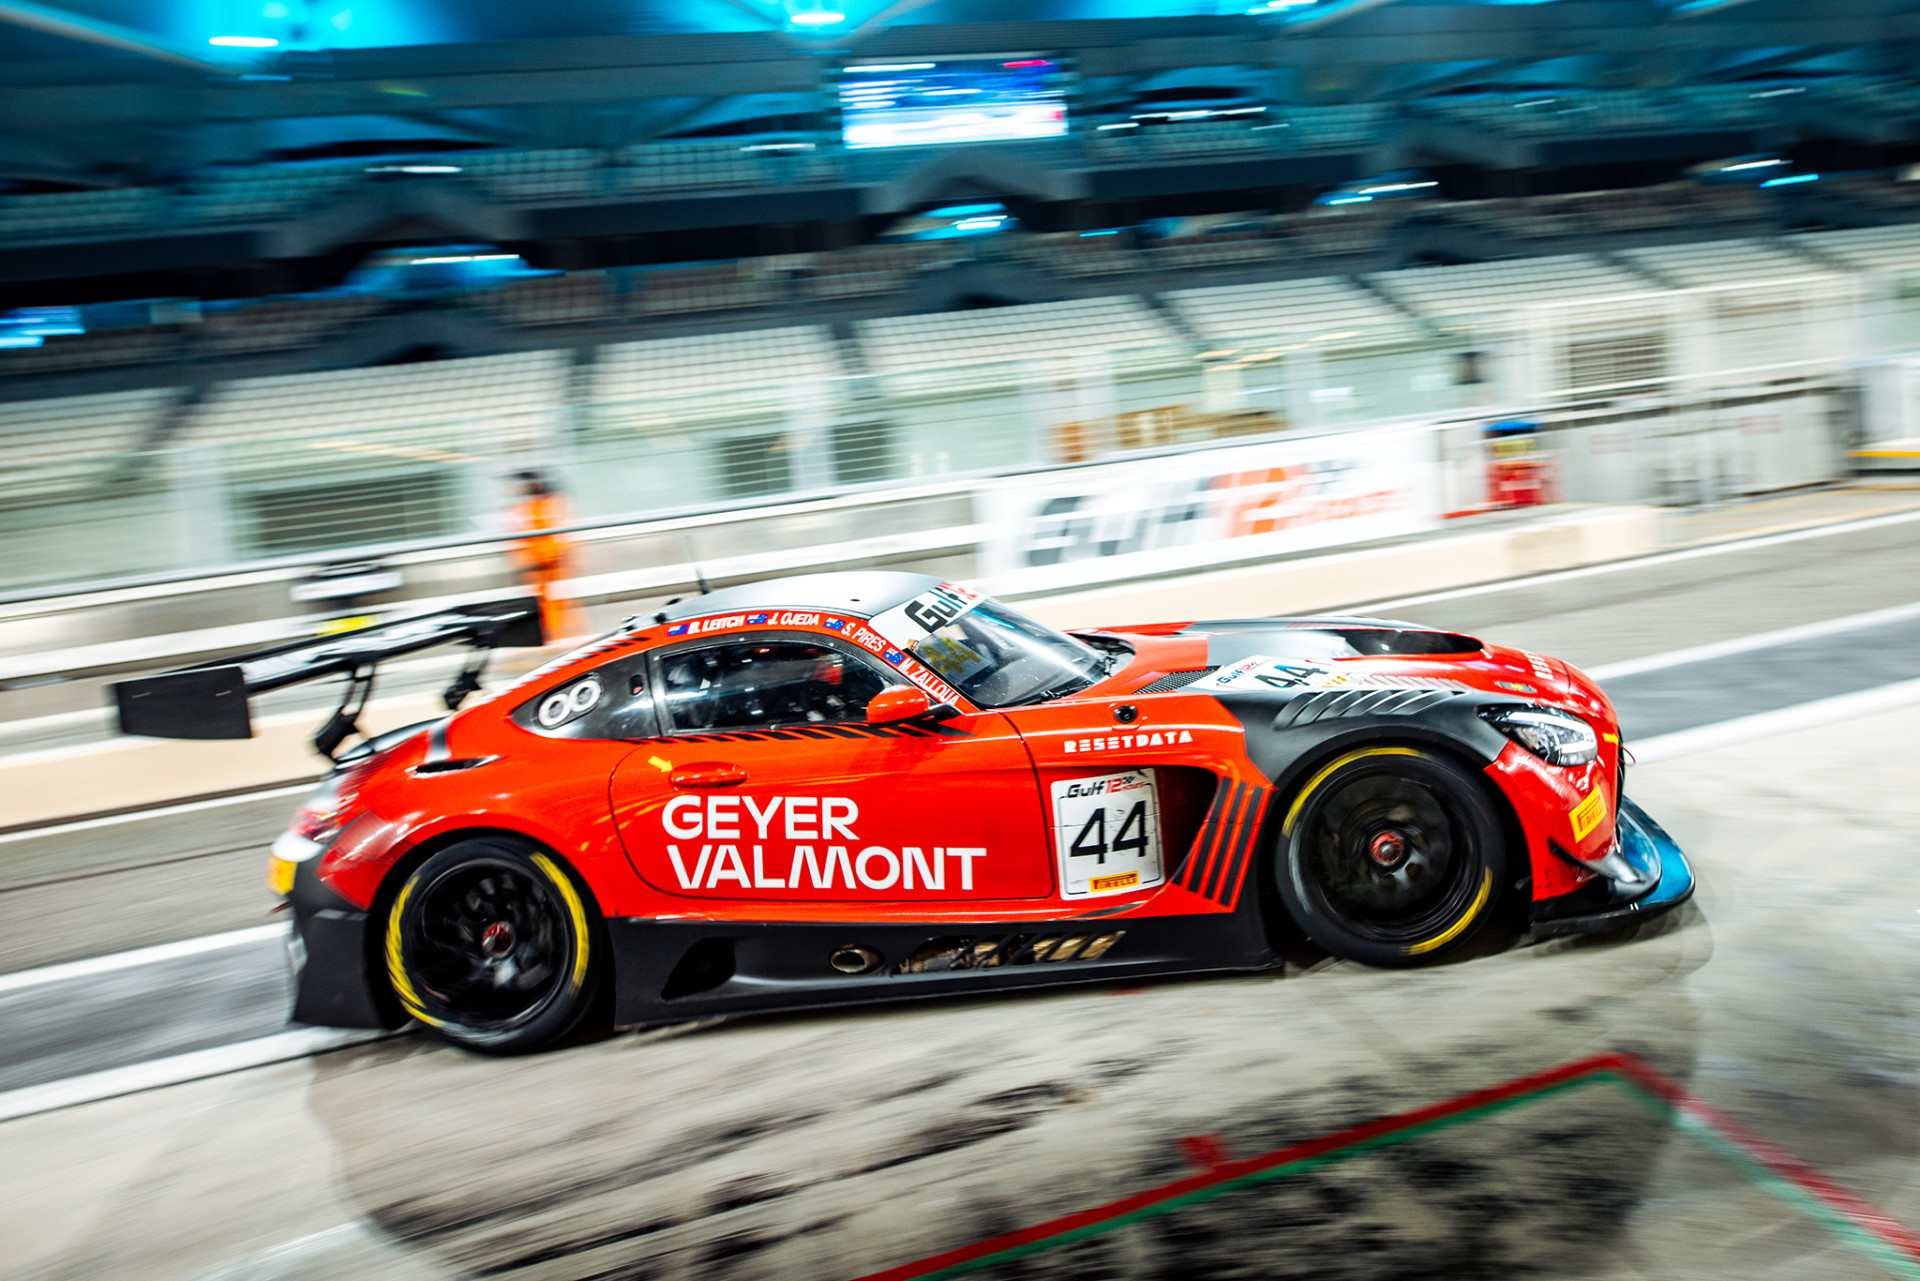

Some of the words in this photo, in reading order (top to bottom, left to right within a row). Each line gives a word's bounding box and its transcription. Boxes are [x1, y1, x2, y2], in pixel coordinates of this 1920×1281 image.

[701, 615, 746, 632] LEITCH
[767, 612, 779, 625] J.
[780, 612, 820, 626] OJEDA
[840, 622, 856, 637] S.
[851, 627, 887, 653] PIRES
[922, 637, 982, 675] 44
[898, 657, 915, 675] M.
[911, 666, 961, 706] ZALLOUA
[1254, 664, 1329, 689] 44
[1064, 730, 1193, 753] RESETDATA
[1067, 780, 1107, 798] Gulf
[662, 795, 860, 840] GEYER
[1070, 800, 1149, 865] 44
[667, 844, 987, 890] VALMONT
[1094, 873, 1137, 890] PIRELLI
